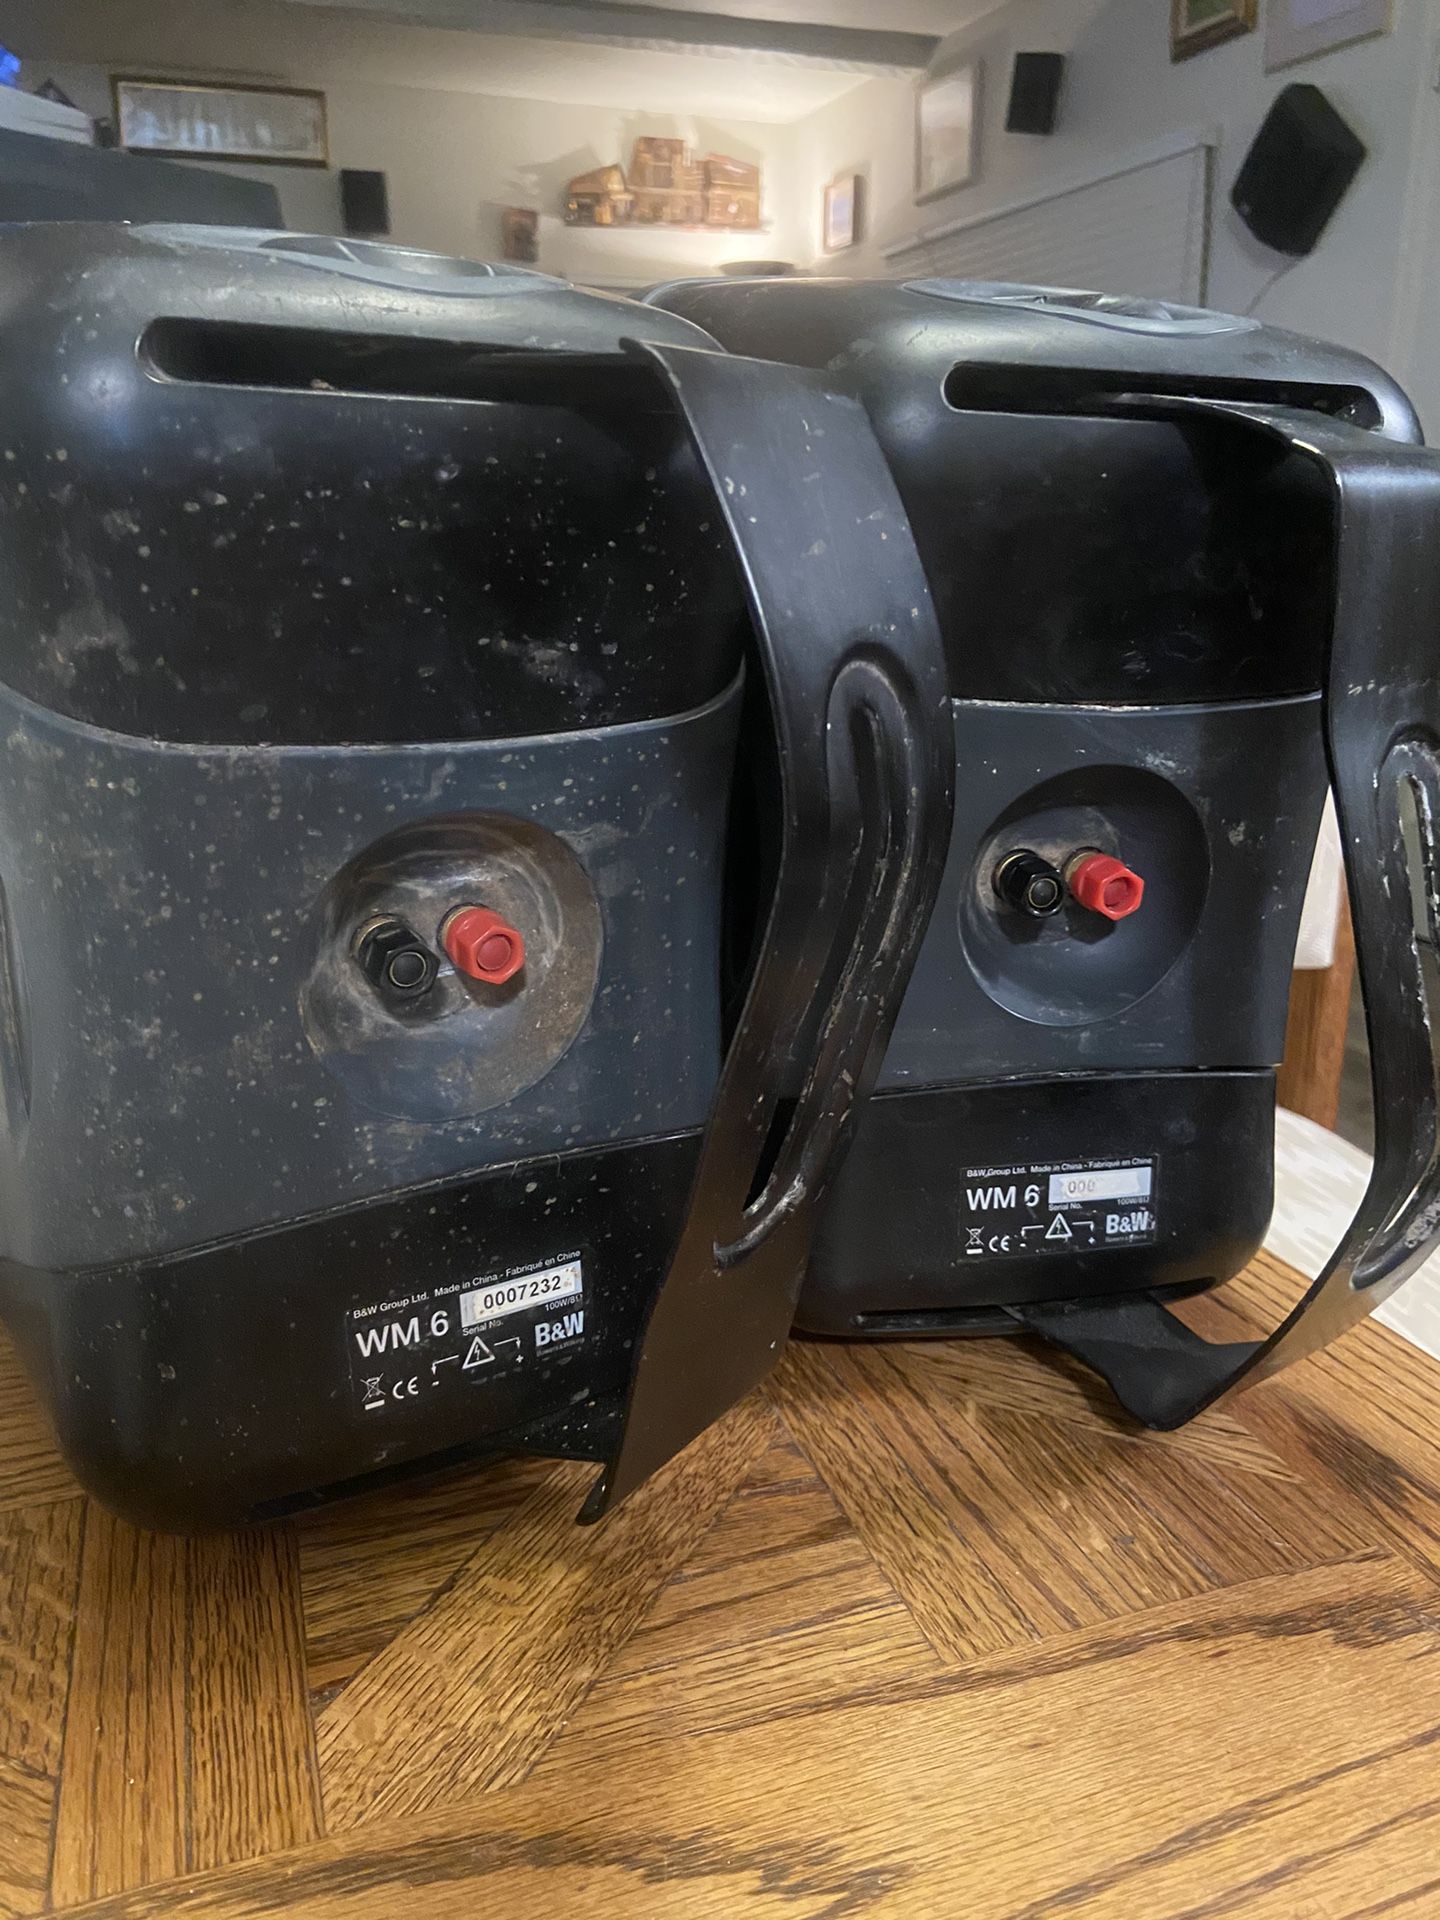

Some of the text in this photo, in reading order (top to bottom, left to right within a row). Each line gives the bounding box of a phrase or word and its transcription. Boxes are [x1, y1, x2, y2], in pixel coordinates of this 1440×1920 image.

[967, 1169, 986, 1178] B&W
[987, 1168, 1011, 1177] Group
[1012, 1166, 1027, 1174] Ltd.
[1030, 1164, 1052, 1173] Made
[1053, 1164, 1061, 1172] in
[1061, 1162, 1083, 1171] China
[1131, 1157, 1153, 1165] Chine
[966, 1184, 1040, 1211] WM 6
[1048, 1202, 1083, 1211] Serial No.
[1105, 1210, 1149, 1234] B&W
[353, 1305, 378, 1319] B&W
[380, 1298, 410, 1312] Group
[411, 1291, 430, 1303] Ltd.
[434, 1283, 461, 1297] Made
[462, 1280, 471, 1289] in
[472, 1274, 498, 1286] China
[505, 1259, 544, 1277] Fabriqué
[545, 1257, 556, 1266] en
[556, 1250, 581, 1262] Chine
[484, 1275, 562, 1309] 0007232
[355, 1310, 449, 1357] WM 6
[462, 1319, 504, 1336] Serial No.
[534, 1310, 584, 1347] B&W
